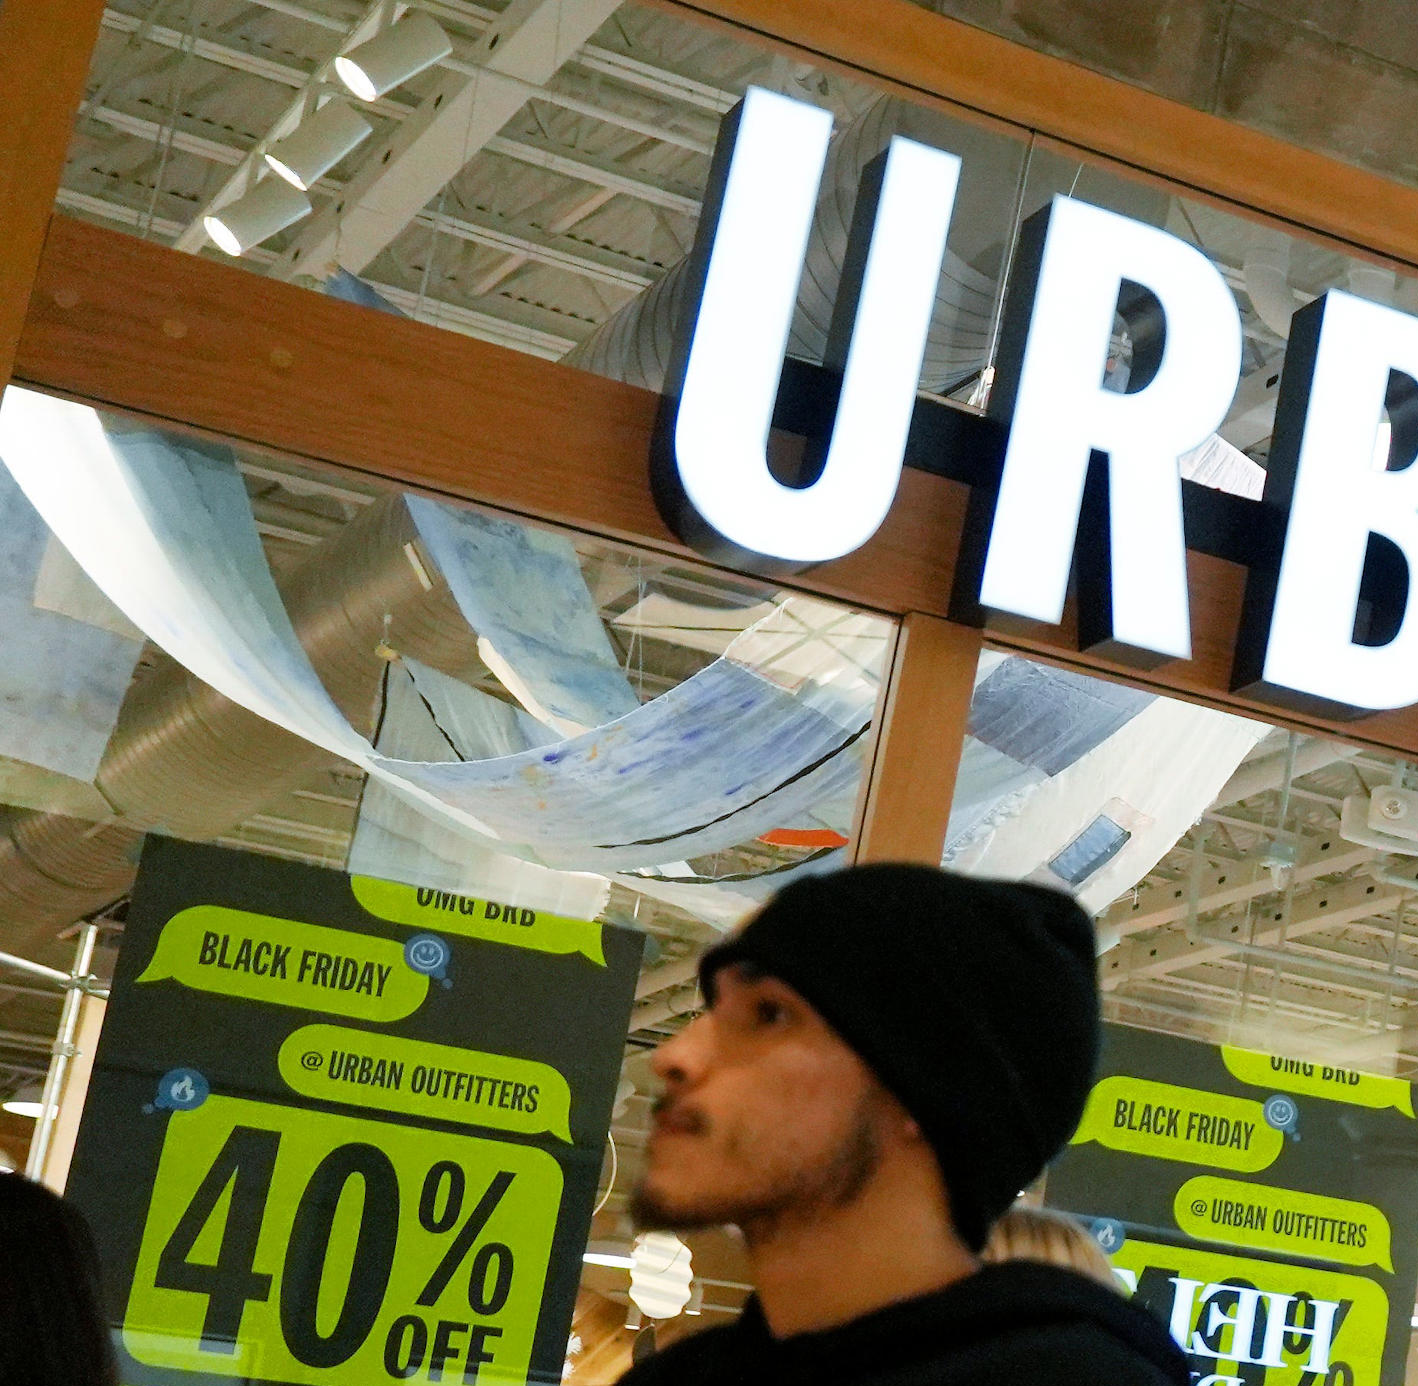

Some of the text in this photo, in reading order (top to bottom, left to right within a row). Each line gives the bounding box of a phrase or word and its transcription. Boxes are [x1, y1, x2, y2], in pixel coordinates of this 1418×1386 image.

[198, 930, 393, 998] BLACK FRIDAY
[301, 1049, 540, 1114] @ URBAN OUTFITTERS
[1113, 1098, 1256, 1150] BLACK FRIDAY
[154, 1124, 518, 1370] 40%
[1190, 1198, 1368, 1248] @ URBAN OUTFITTERS
[383, 1314, 503, 1386] OFF
